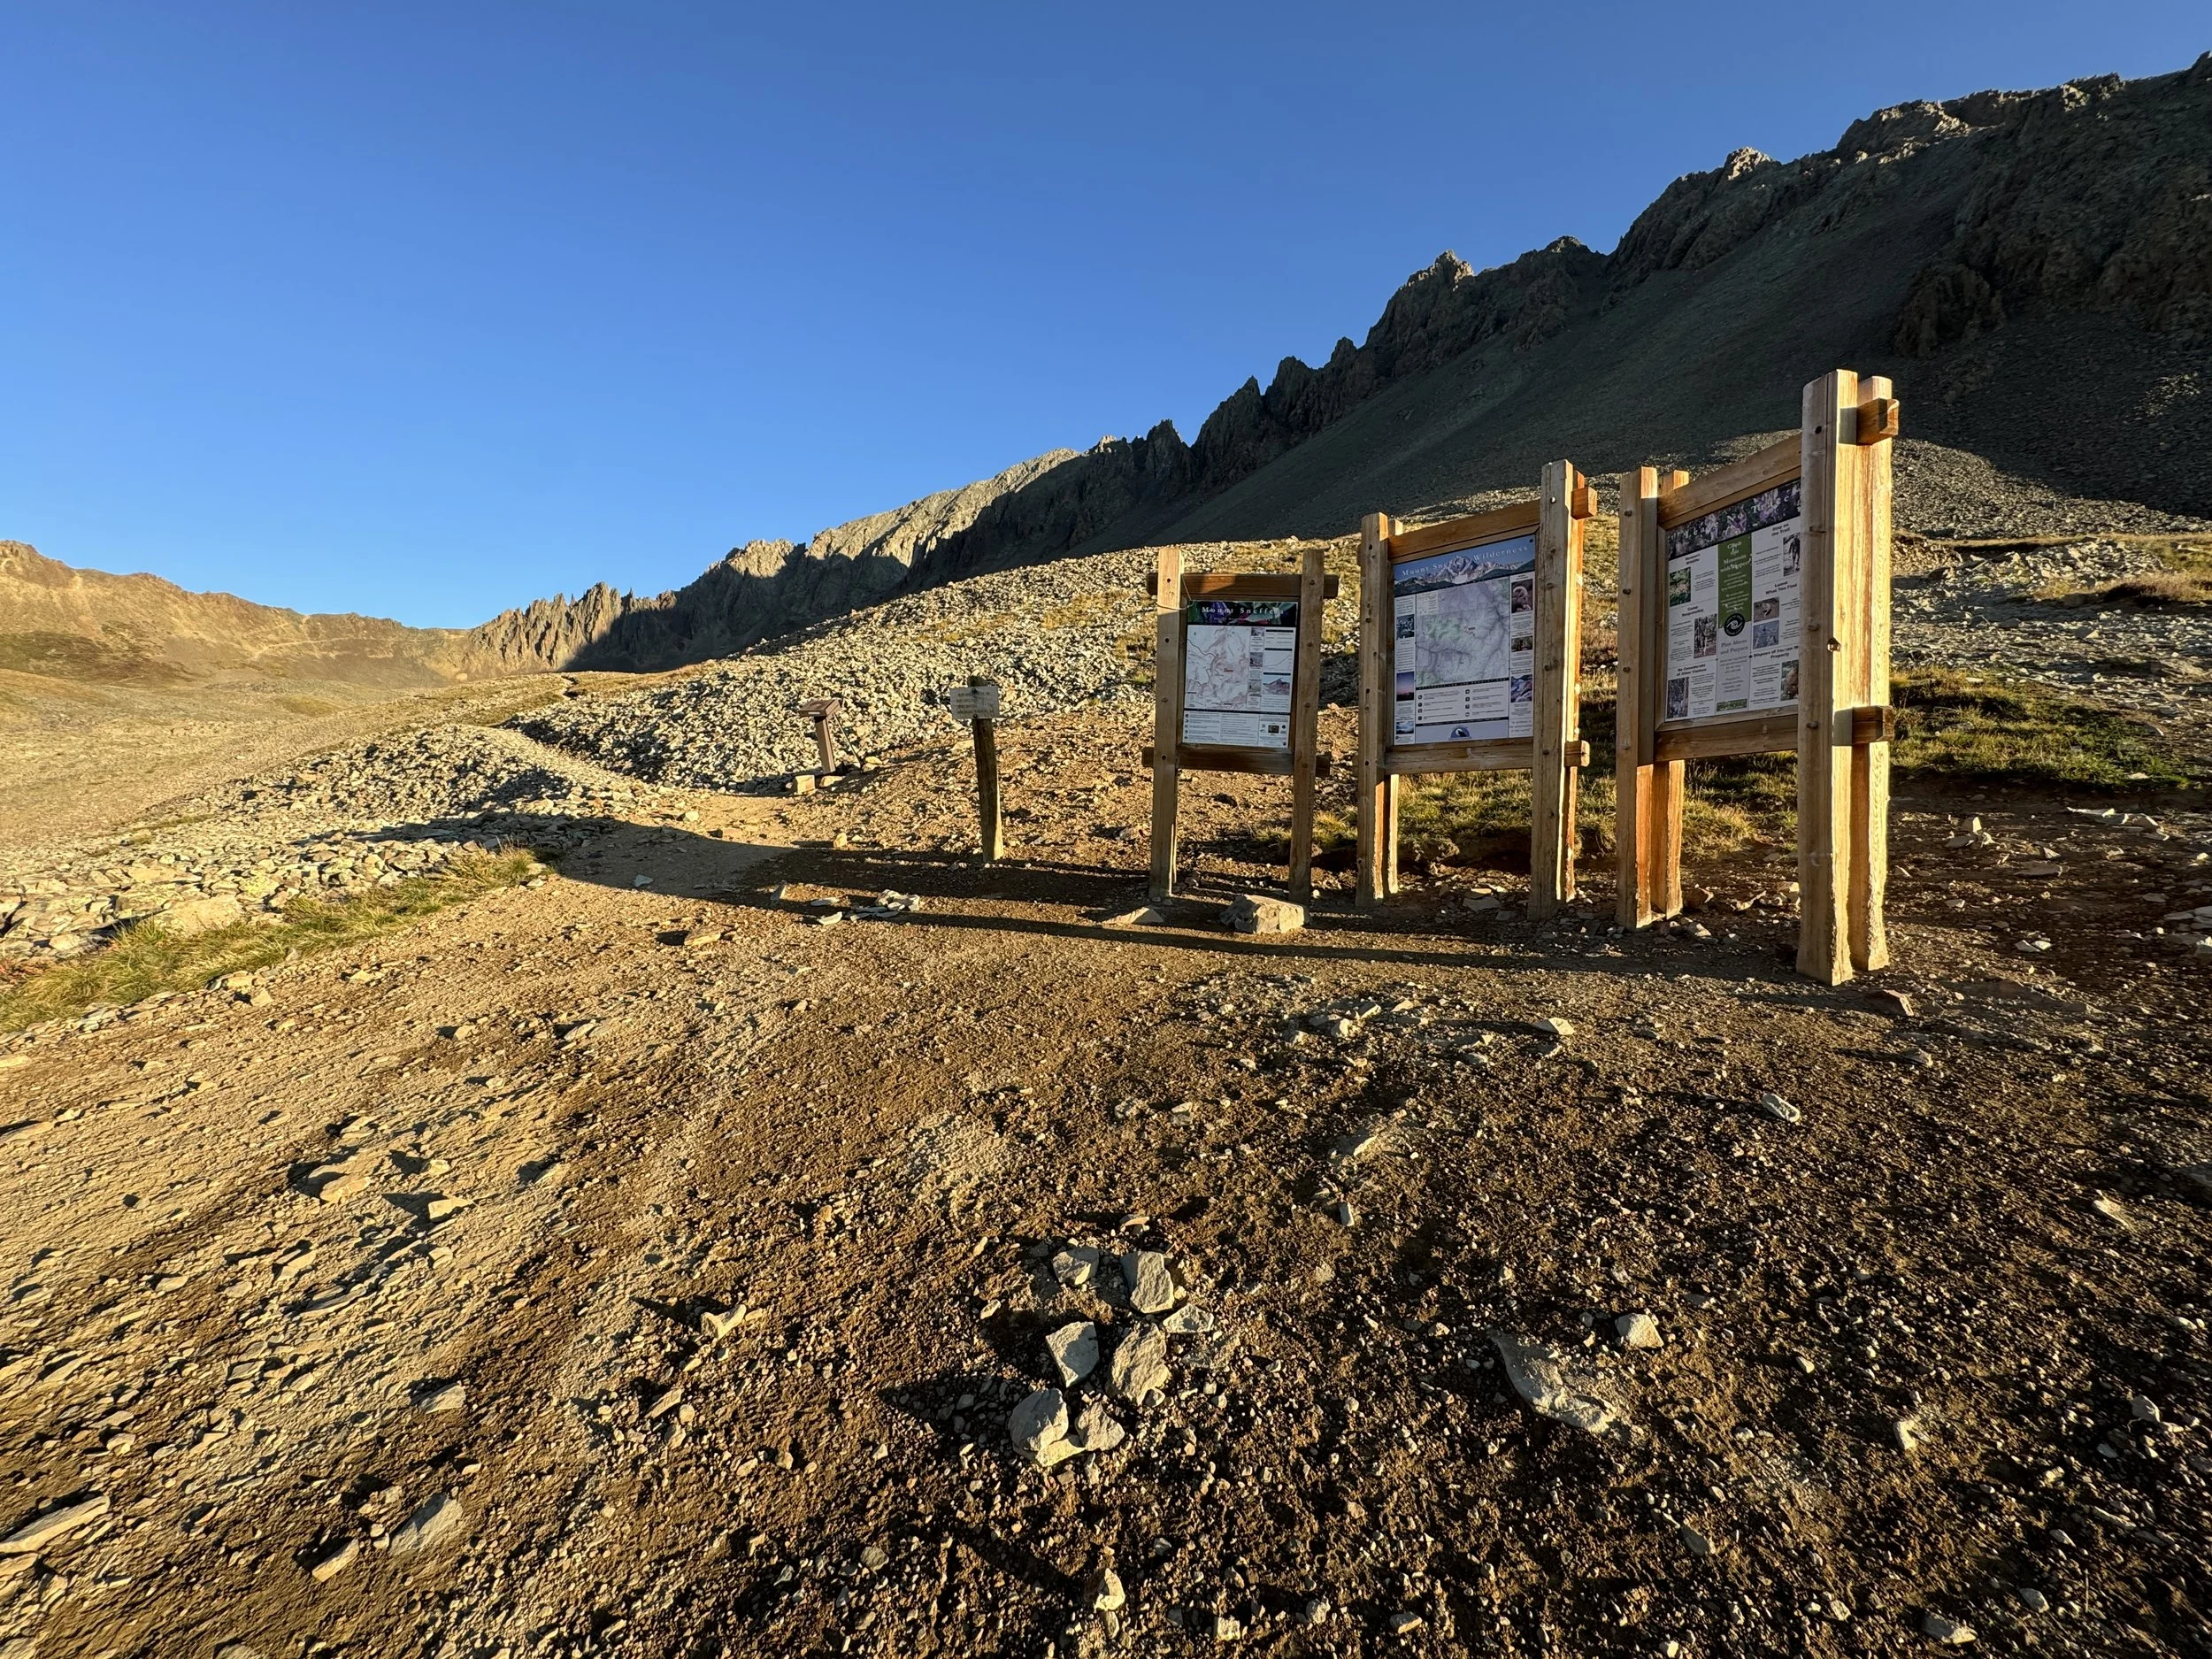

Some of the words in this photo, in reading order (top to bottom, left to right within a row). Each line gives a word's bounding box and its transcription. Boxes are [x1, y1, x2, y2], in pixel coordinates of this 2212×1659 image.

[1751, 496, 1790, 514] Trce
[1402, 567, 1429, 576] Mount
[1473, 546, 1528, 562] Wilderness
